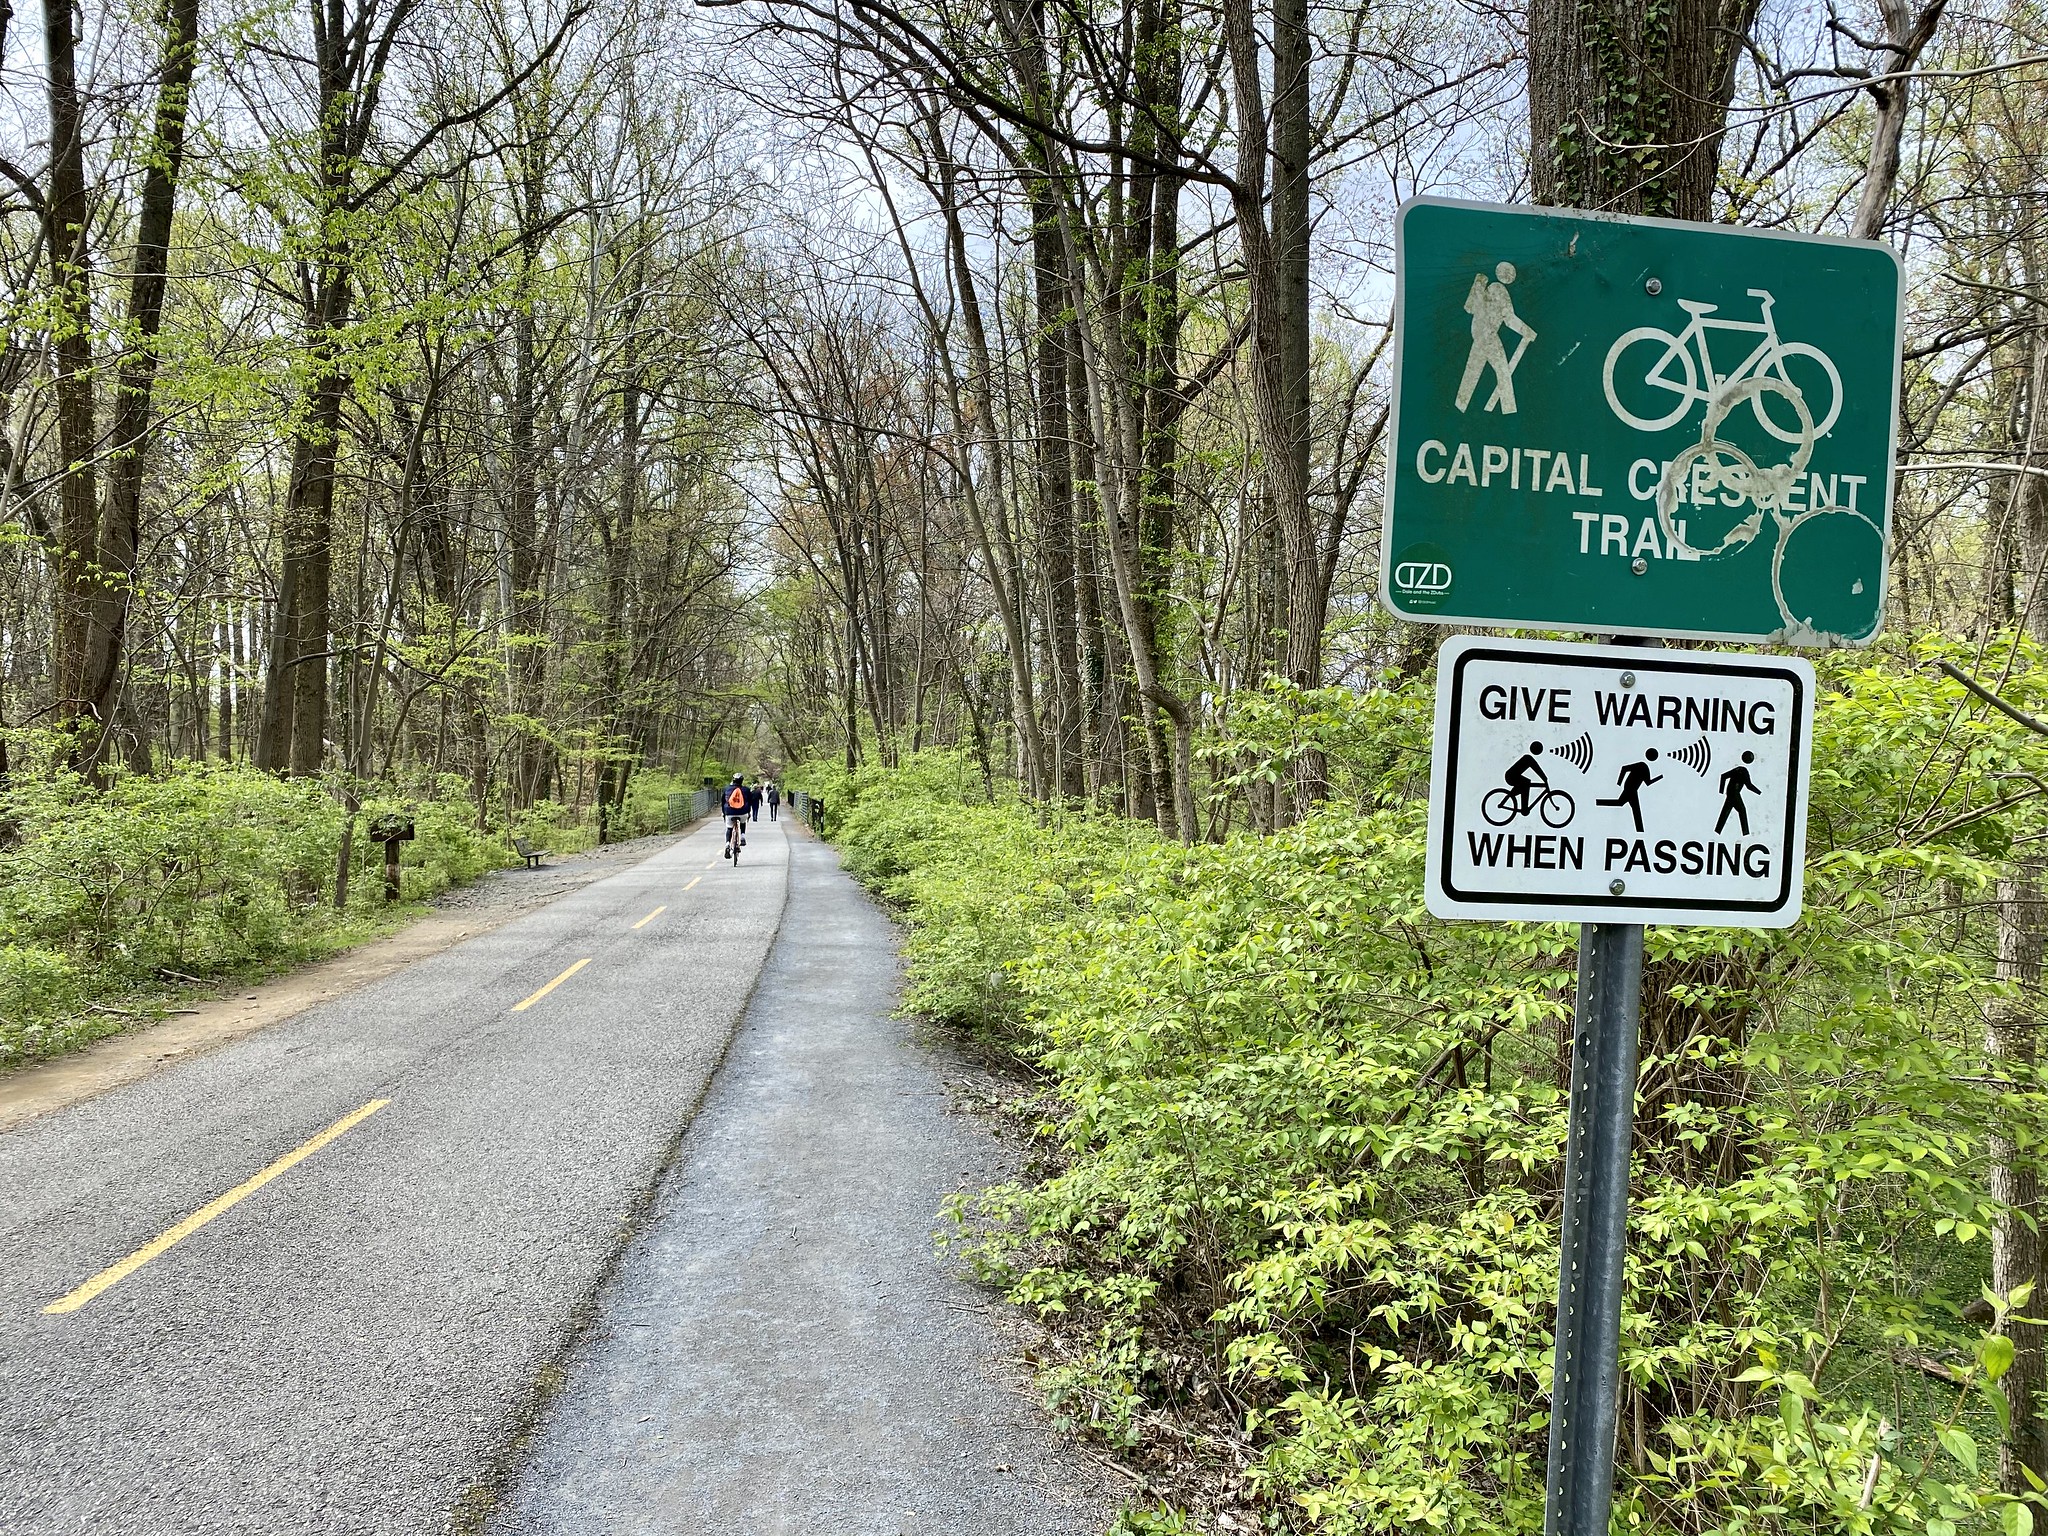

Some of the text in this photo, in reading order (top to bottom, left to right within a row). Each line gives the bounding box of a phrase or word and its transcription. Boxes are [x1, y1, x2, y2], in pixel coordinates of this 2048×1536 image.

[1416, 439, 1867, 512] CAPITAL CESENT
[1572, 511, 1700, 561] TRAIL
[1479, 685, 1775, 735] GIVE WARNING
[1467, 831, 1771, 878] WHEN PASSING
